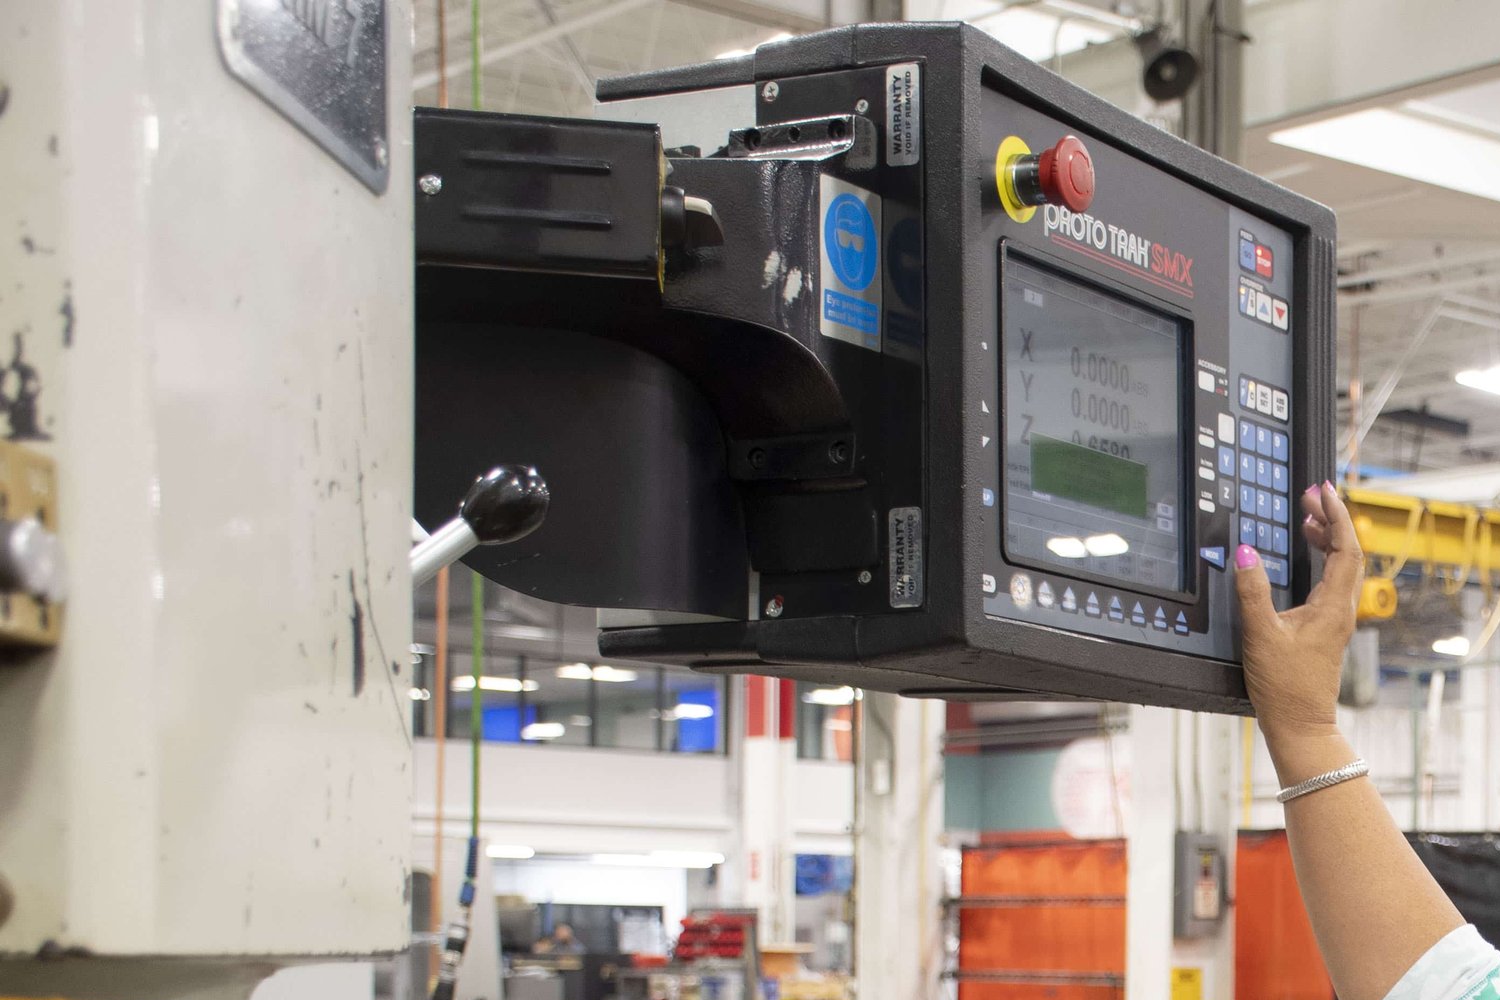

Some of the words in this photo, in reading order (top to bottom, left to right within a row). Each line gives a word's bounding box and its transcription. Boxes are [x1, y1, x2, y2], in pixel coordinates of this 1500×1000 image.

[892, 75, 902, 155] WARRANTY
[905, 120, 912, 130] IF
[1044, 203, 1107, 250] PROTO
[1151, 243, 1193, 287] SMX
[1020, 327, 1034, 363] X
[1070, 346, 1130, 394] 0.0000
[1198, 359, 1227, 375] ACCESSORY
[1020, 370, 1035, 403] Y
[1070, 387, 1130, 434] 0.0000
[1020, 414, 1034, 446] Z
[1205, 550, 1219, 561] MODE
